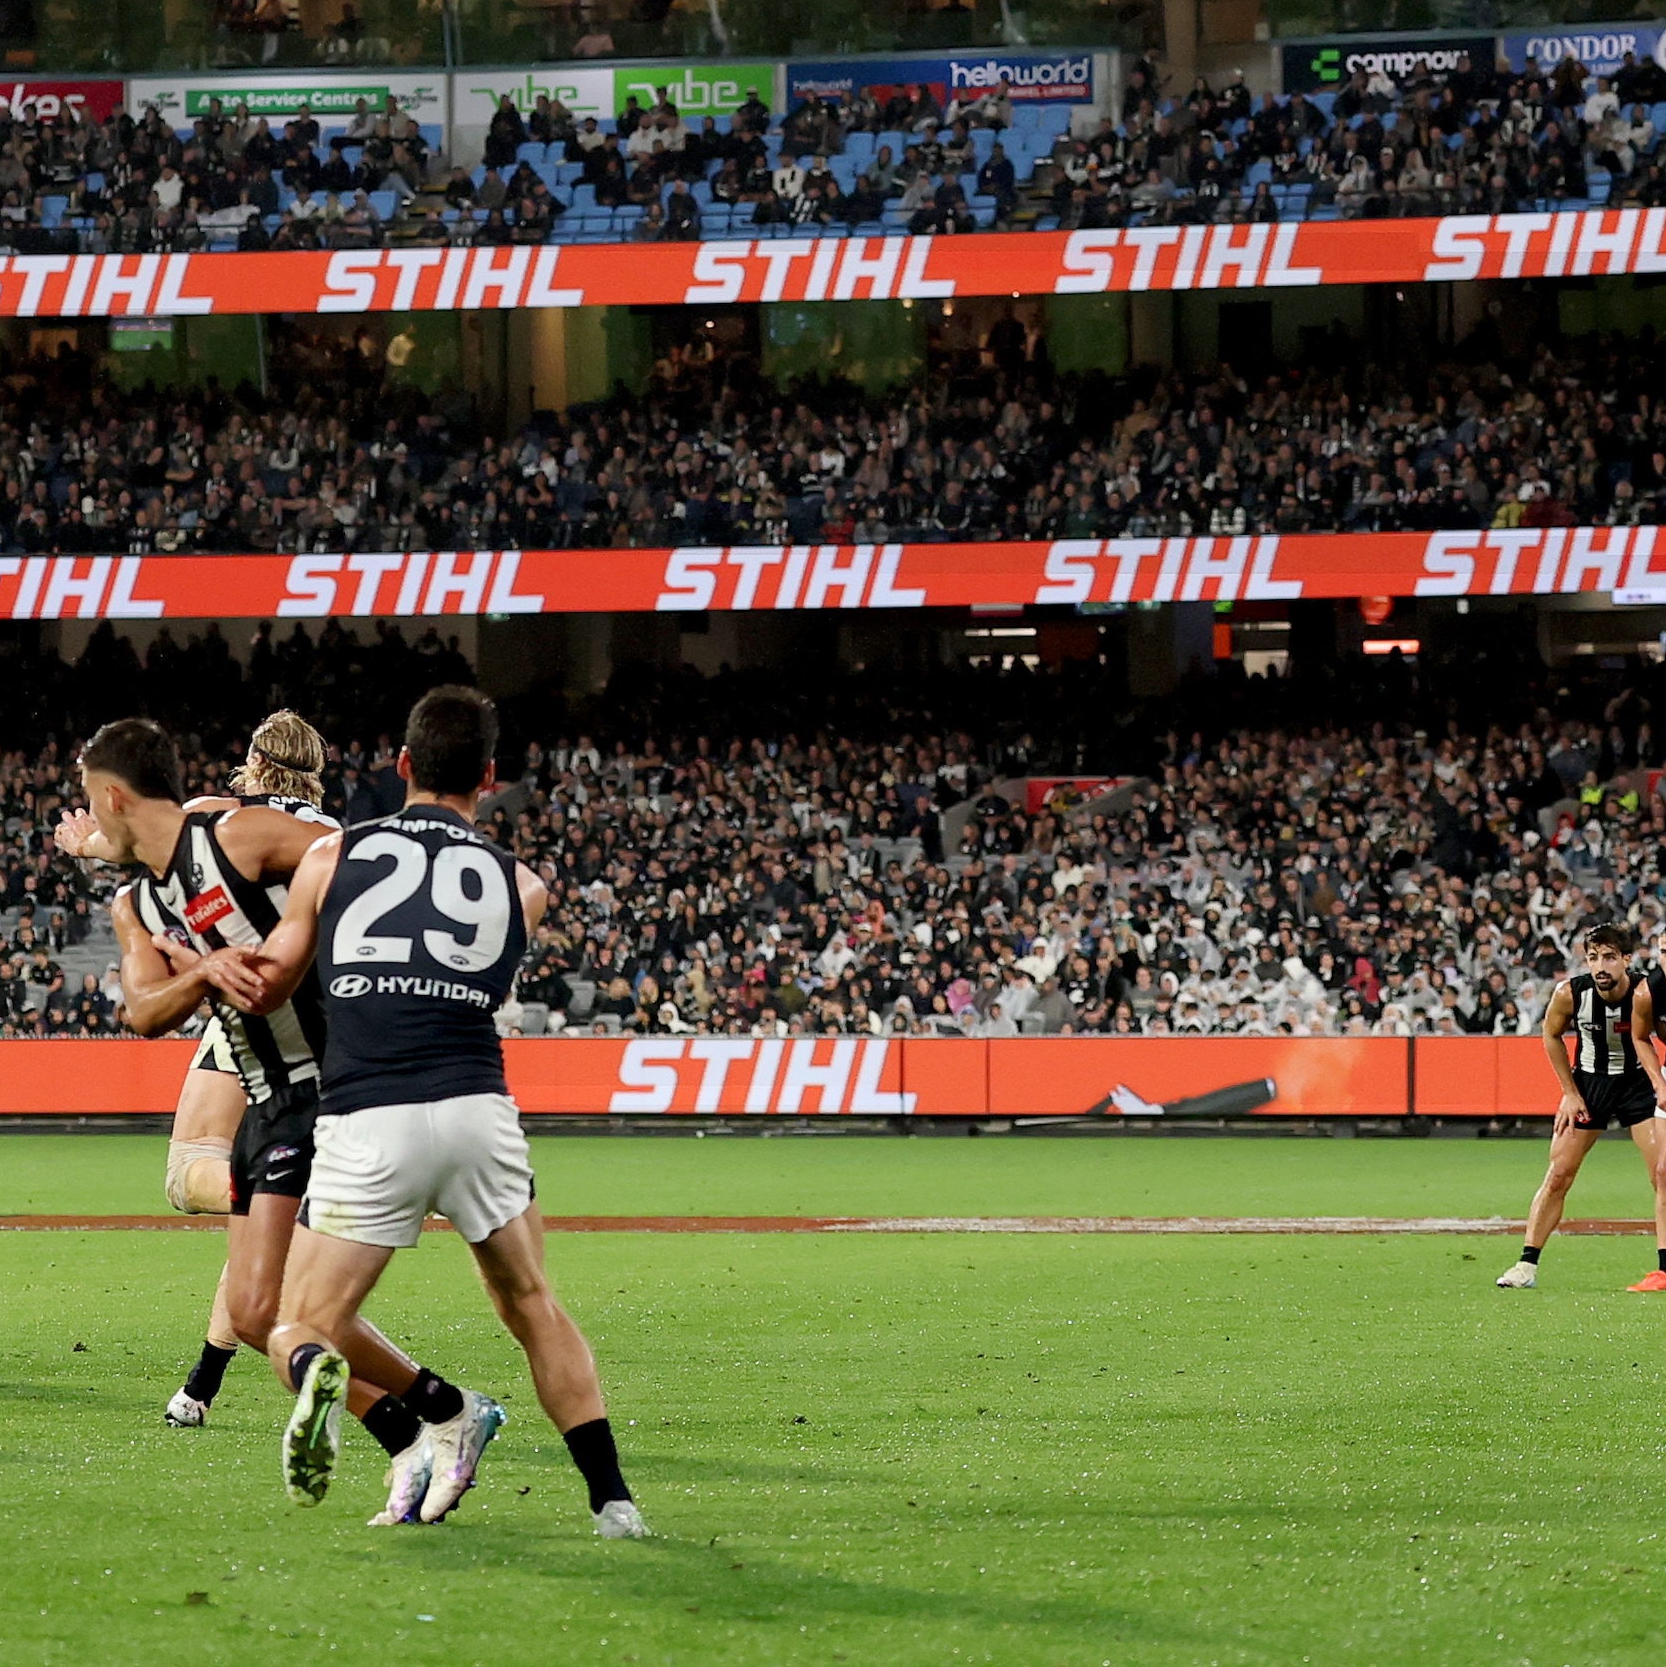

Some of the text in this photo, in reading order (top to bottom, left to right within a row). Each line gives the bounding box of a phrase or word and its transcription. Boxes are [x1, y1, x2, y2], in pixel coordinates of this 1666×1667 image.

[1526, 33, 1637, 62] CONDOR
[627, 71, 745, 109] vibe
[949, 58, 1090, 87] helloworld
[247, 92, 302, 107] Service
[470, 74, 598, 112] vibe
[317, 246, 583, 312] STIHL
[685, 236, 955, 303] STIHL
[1055, 223, 1322, 293] STIHL
[277, 552, 544, 616] STIHL
[656, 545, 926, 610] STIHL
[1036, 537, 1302, 603] STIHL
[332, 831, 512, 973] 29
[377, 976, 490, 1009] HYUNDAI
[609, 1039, 918, 1114] STIHL
